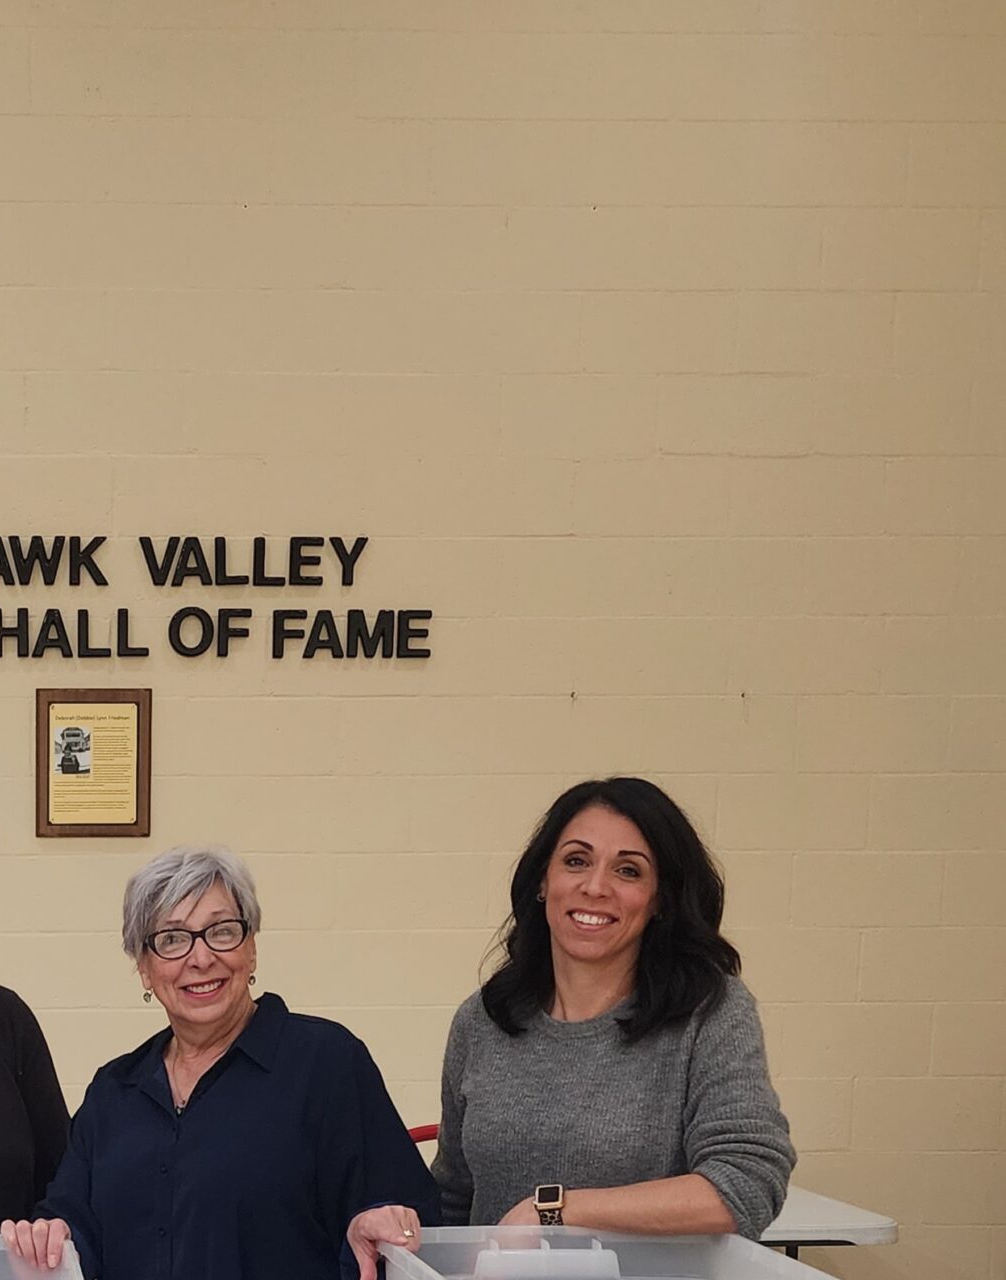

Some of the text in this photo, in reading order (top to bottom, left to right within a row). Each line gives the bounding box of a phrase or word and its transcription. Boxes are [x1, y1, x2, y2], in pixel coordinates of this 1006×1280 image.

[139, 536, 369, 587] VALLEY
[168, 607, 252, 658] OF
[272, 609, 434, 659] FAME
